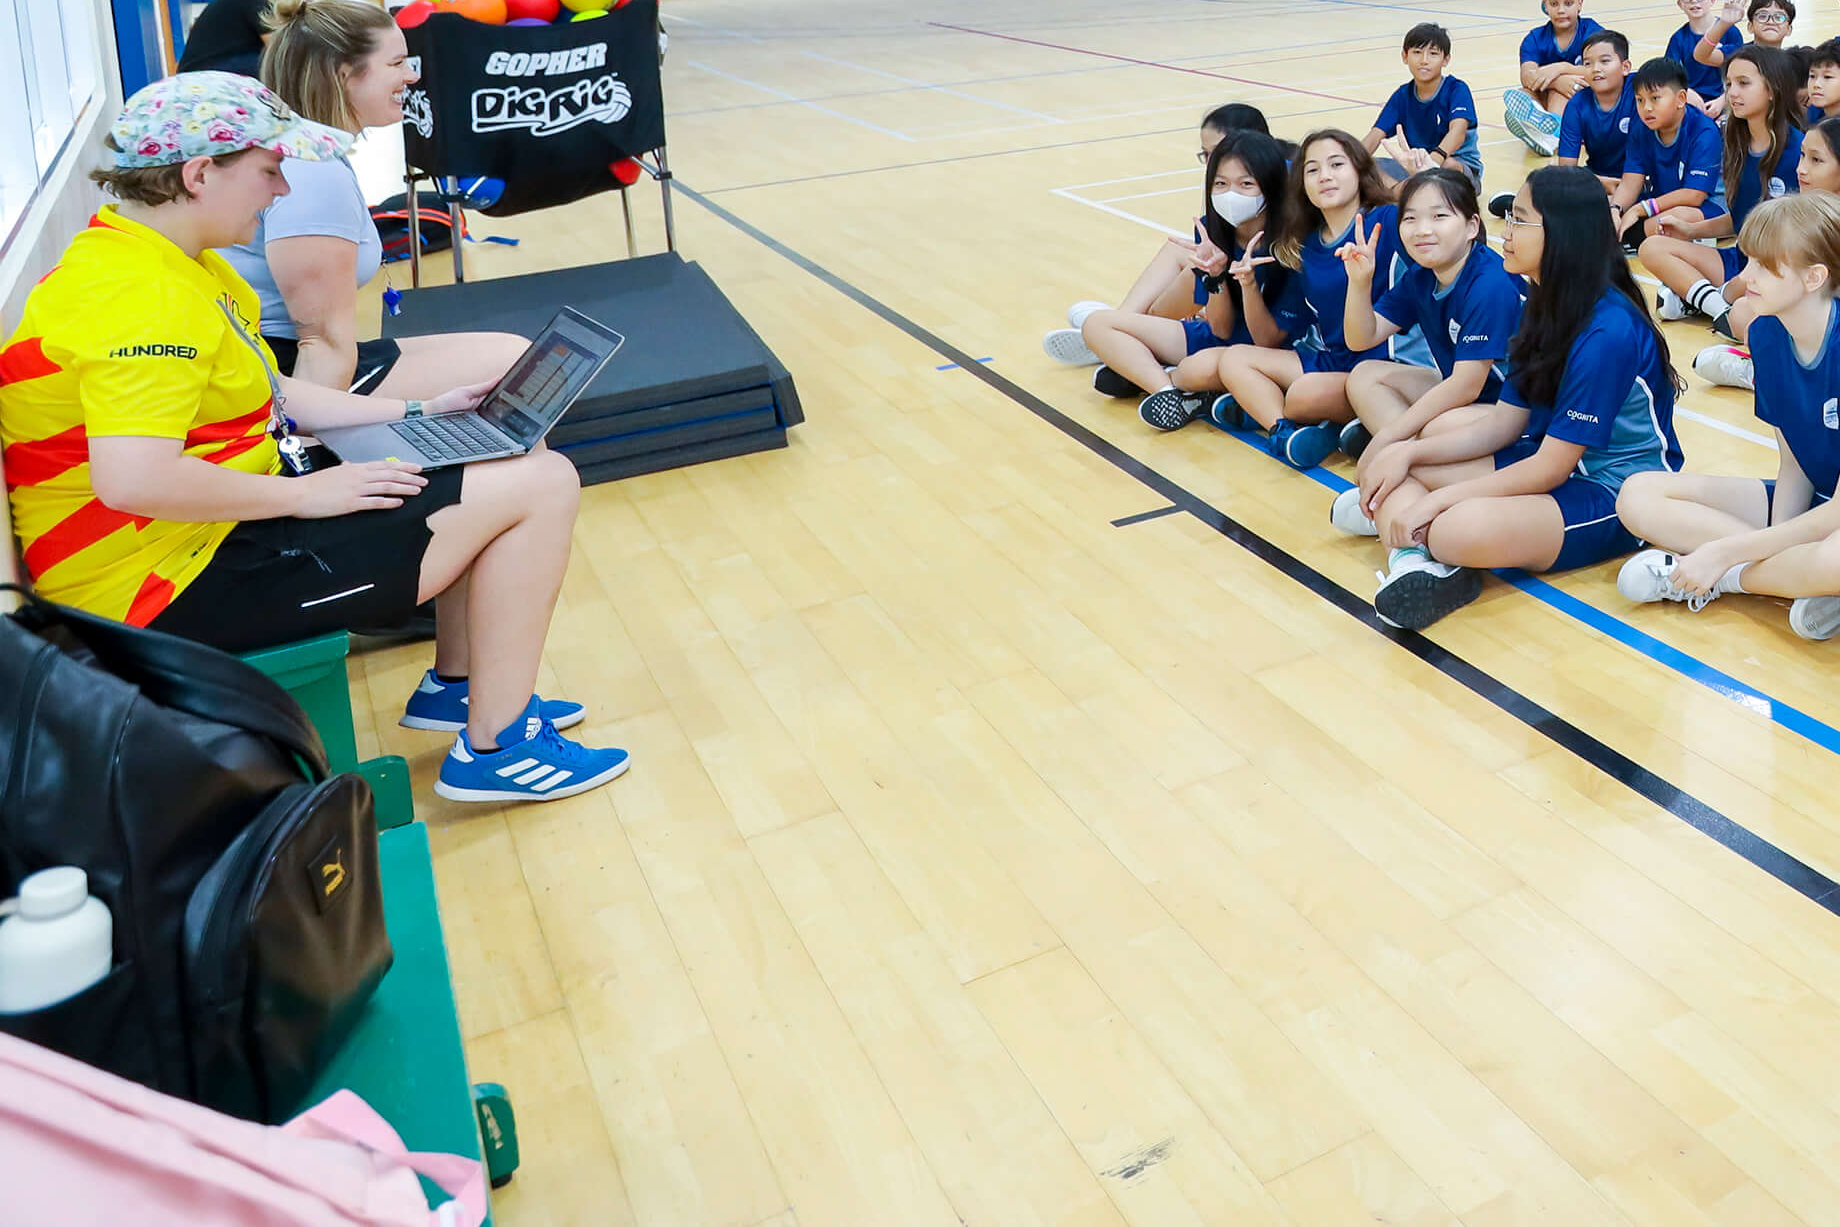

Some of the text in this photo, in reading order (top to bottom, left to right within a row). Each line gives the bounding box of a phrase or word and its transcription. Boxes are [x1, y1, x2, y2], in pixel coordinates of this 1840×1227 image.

[485, 42, 608, 77] GOPHER
[109, 344, 197, 360] HUNDRED
[1566, 408, 1604, 424] COGNITA
